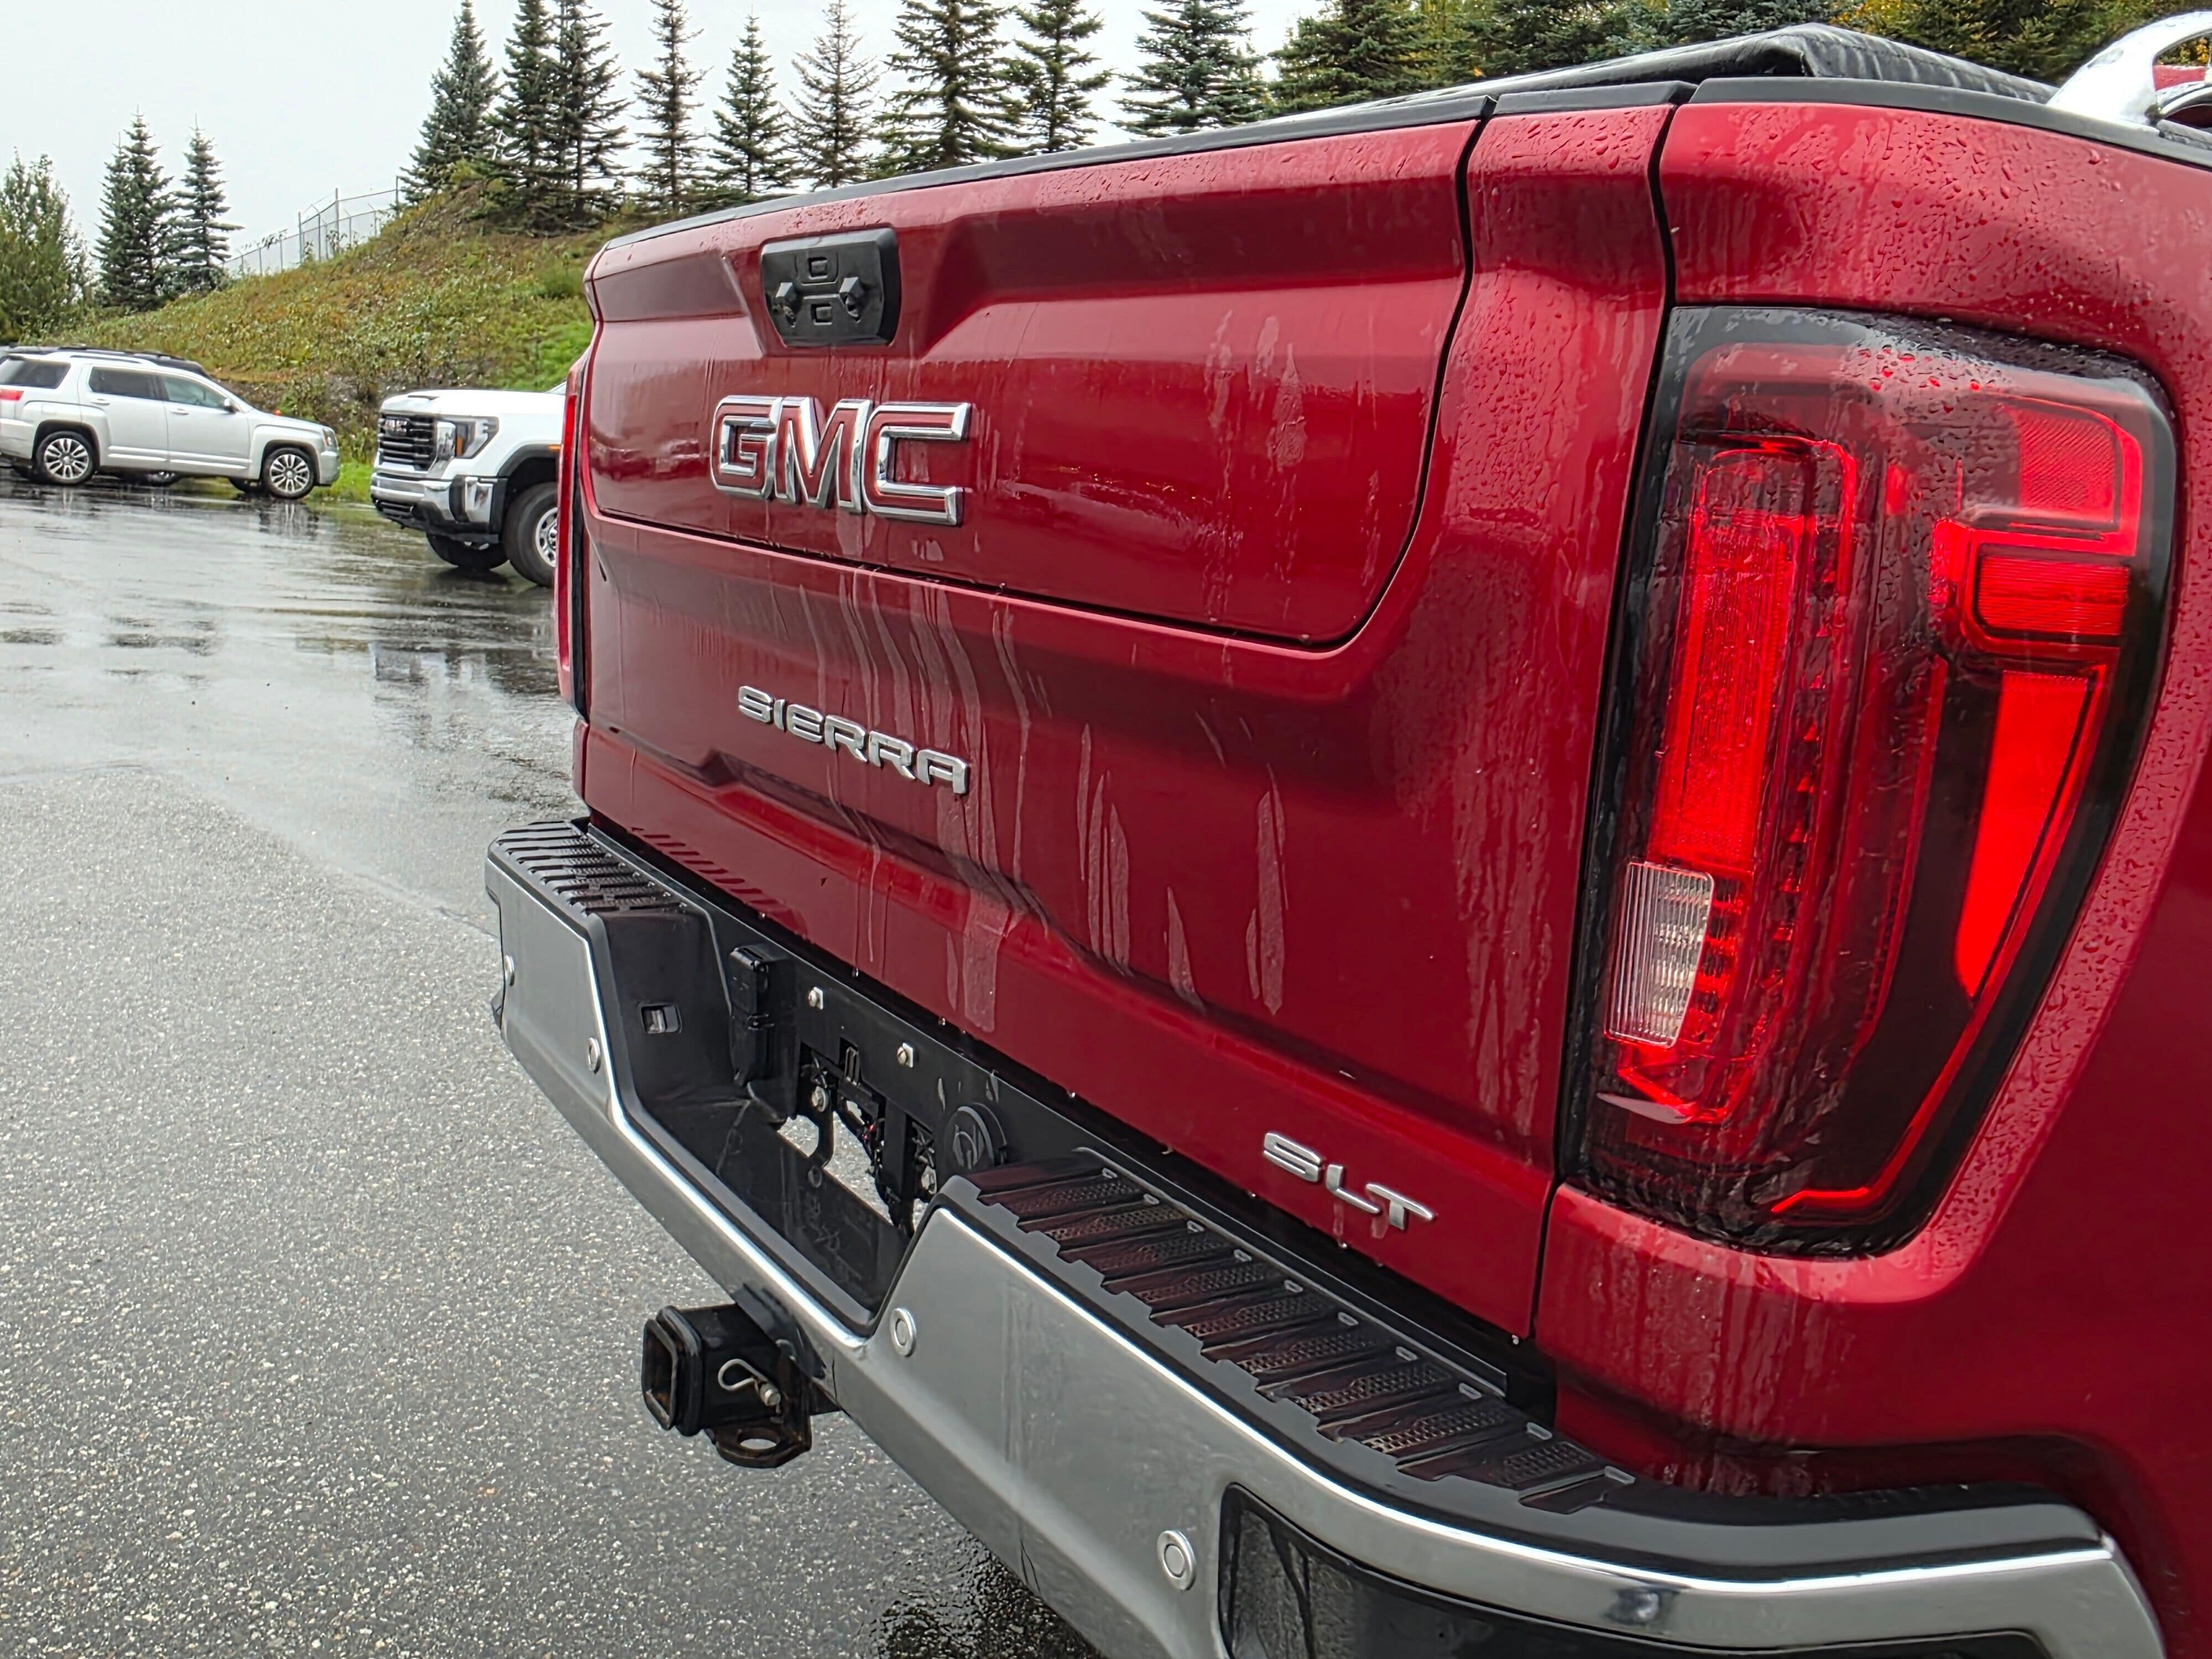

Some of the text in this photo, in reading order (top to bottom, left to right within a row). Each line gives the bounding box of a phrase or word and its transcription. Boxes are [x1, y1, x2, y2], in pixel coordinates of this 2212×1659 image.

[711, 395, 969, 526] GMC
[738, 685, 968, 795] SIERRA
[1263, 1132, 1434, 1230] SLT
